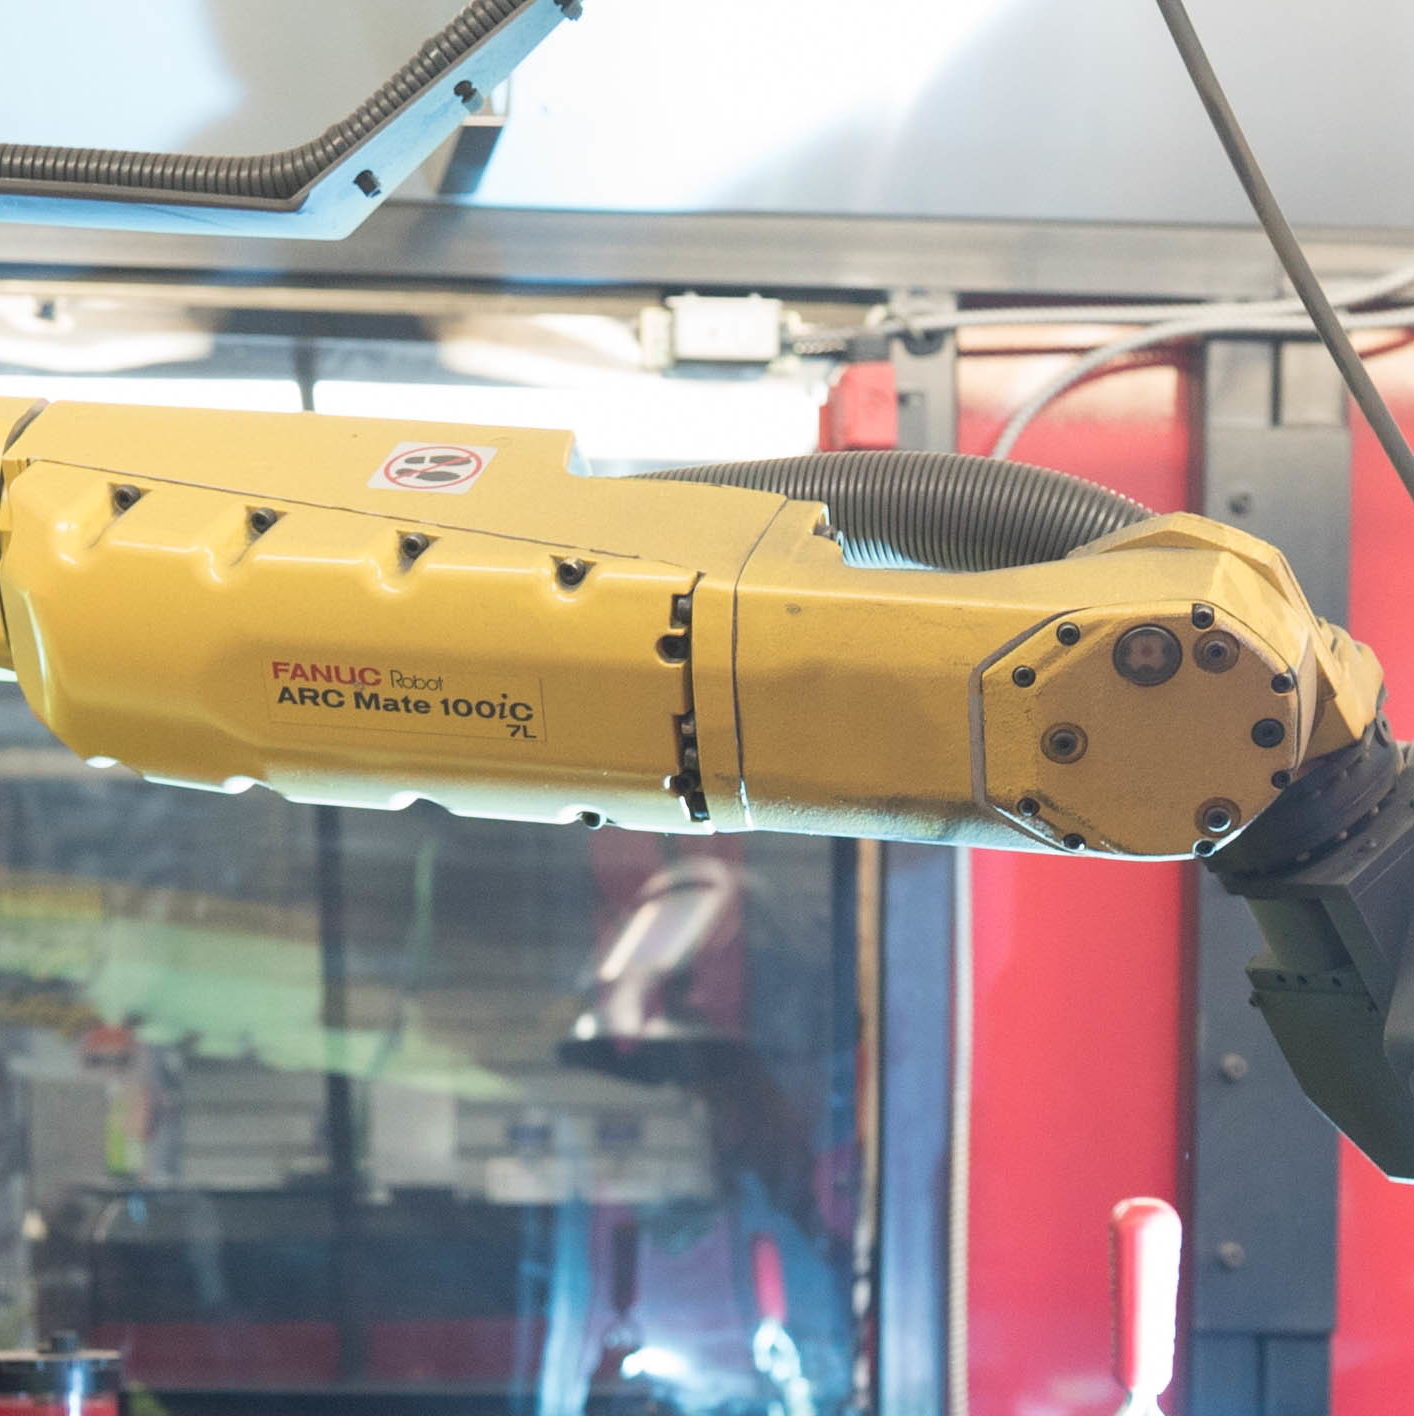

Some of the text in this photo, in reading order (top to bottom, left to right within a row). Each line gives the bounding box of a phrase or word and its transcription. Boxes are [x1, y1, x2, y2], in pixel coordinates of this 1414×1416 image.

[272, 661, 443, 691] FANUC Robot
[277, 686, 533, 721] ARC Mate 100iC
[506, 724, 537, 739] 7L
